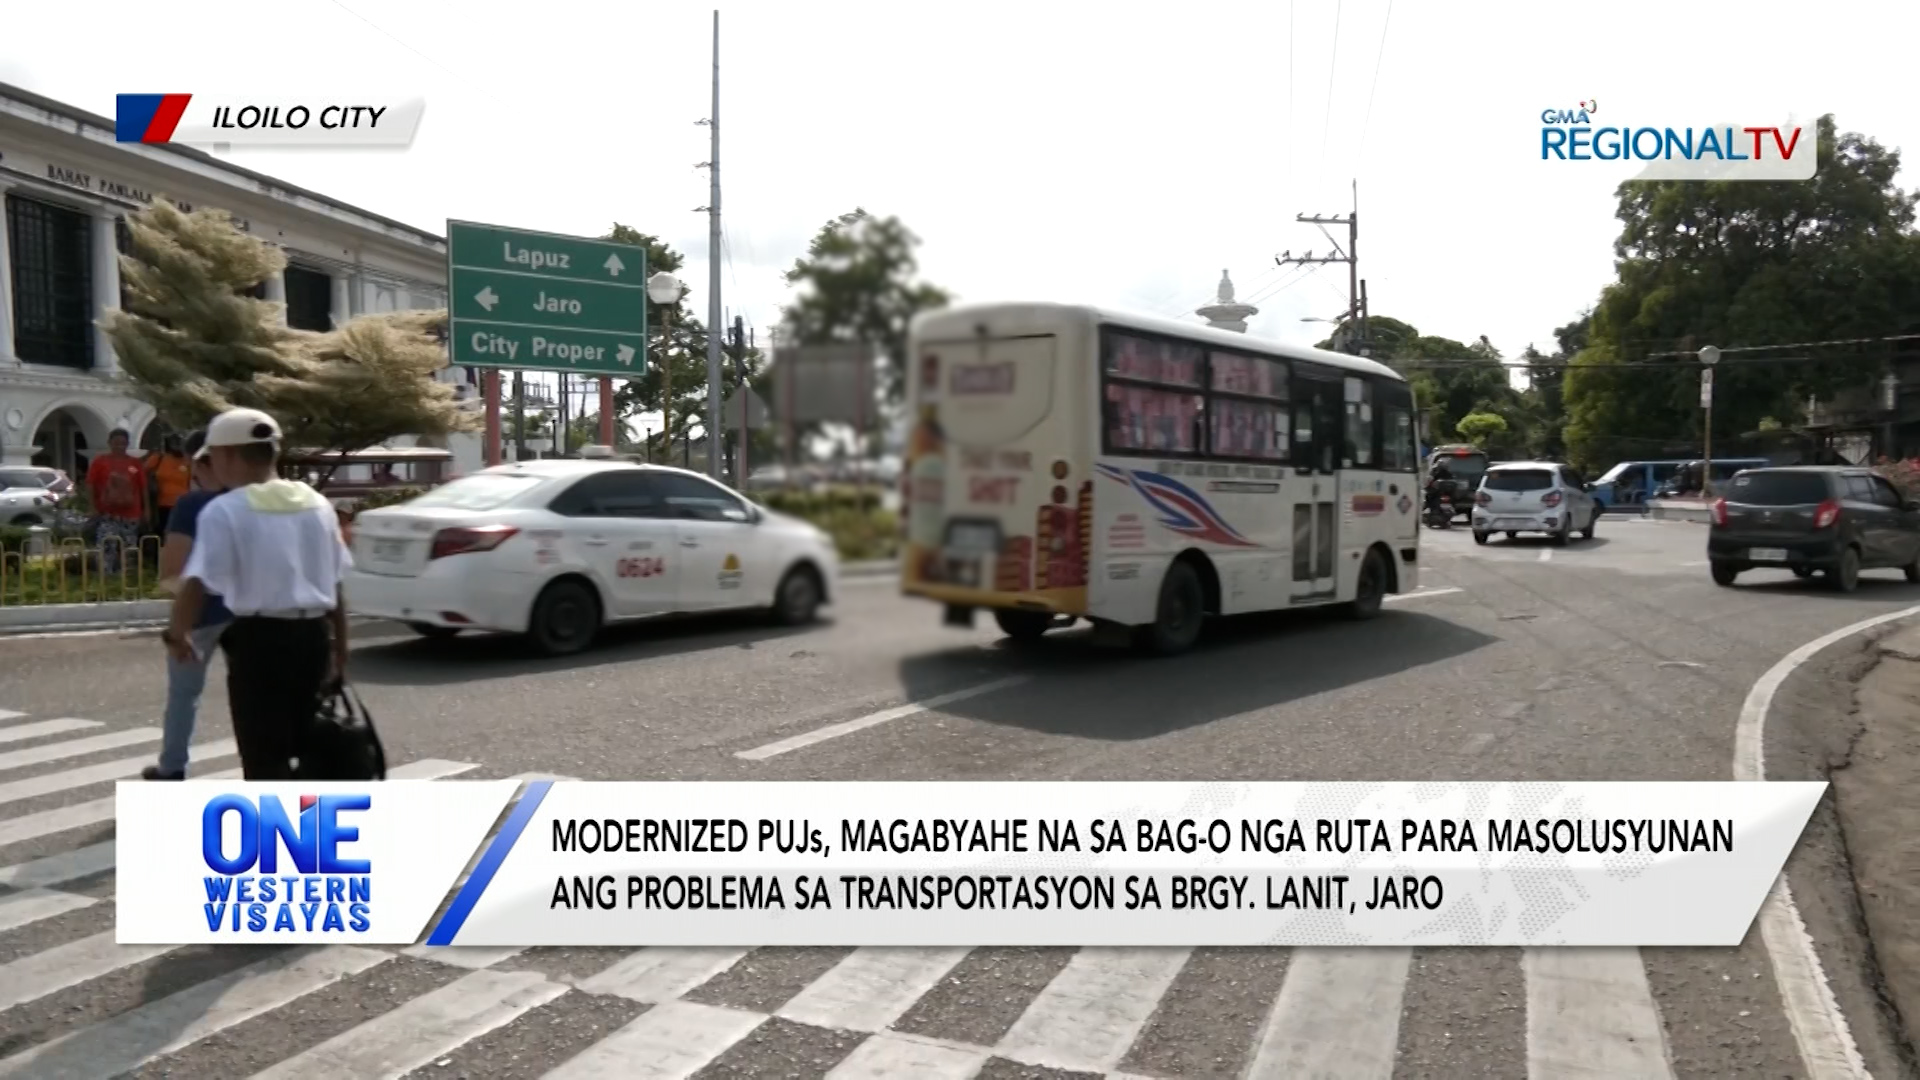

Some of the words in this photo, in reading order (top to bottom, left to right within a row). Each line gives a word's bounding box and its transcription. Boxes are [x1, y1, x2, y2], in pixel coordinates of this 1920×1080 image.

[46, 164, 91, 189] BAHAY
[503, 240, 571, 270] Lapuz
[532, 291, 582, 315] Jaro
[471, 331, 520, 360] City
[532, 336, 606, 364] Proper
[616, 556, 665, 578] 0624
